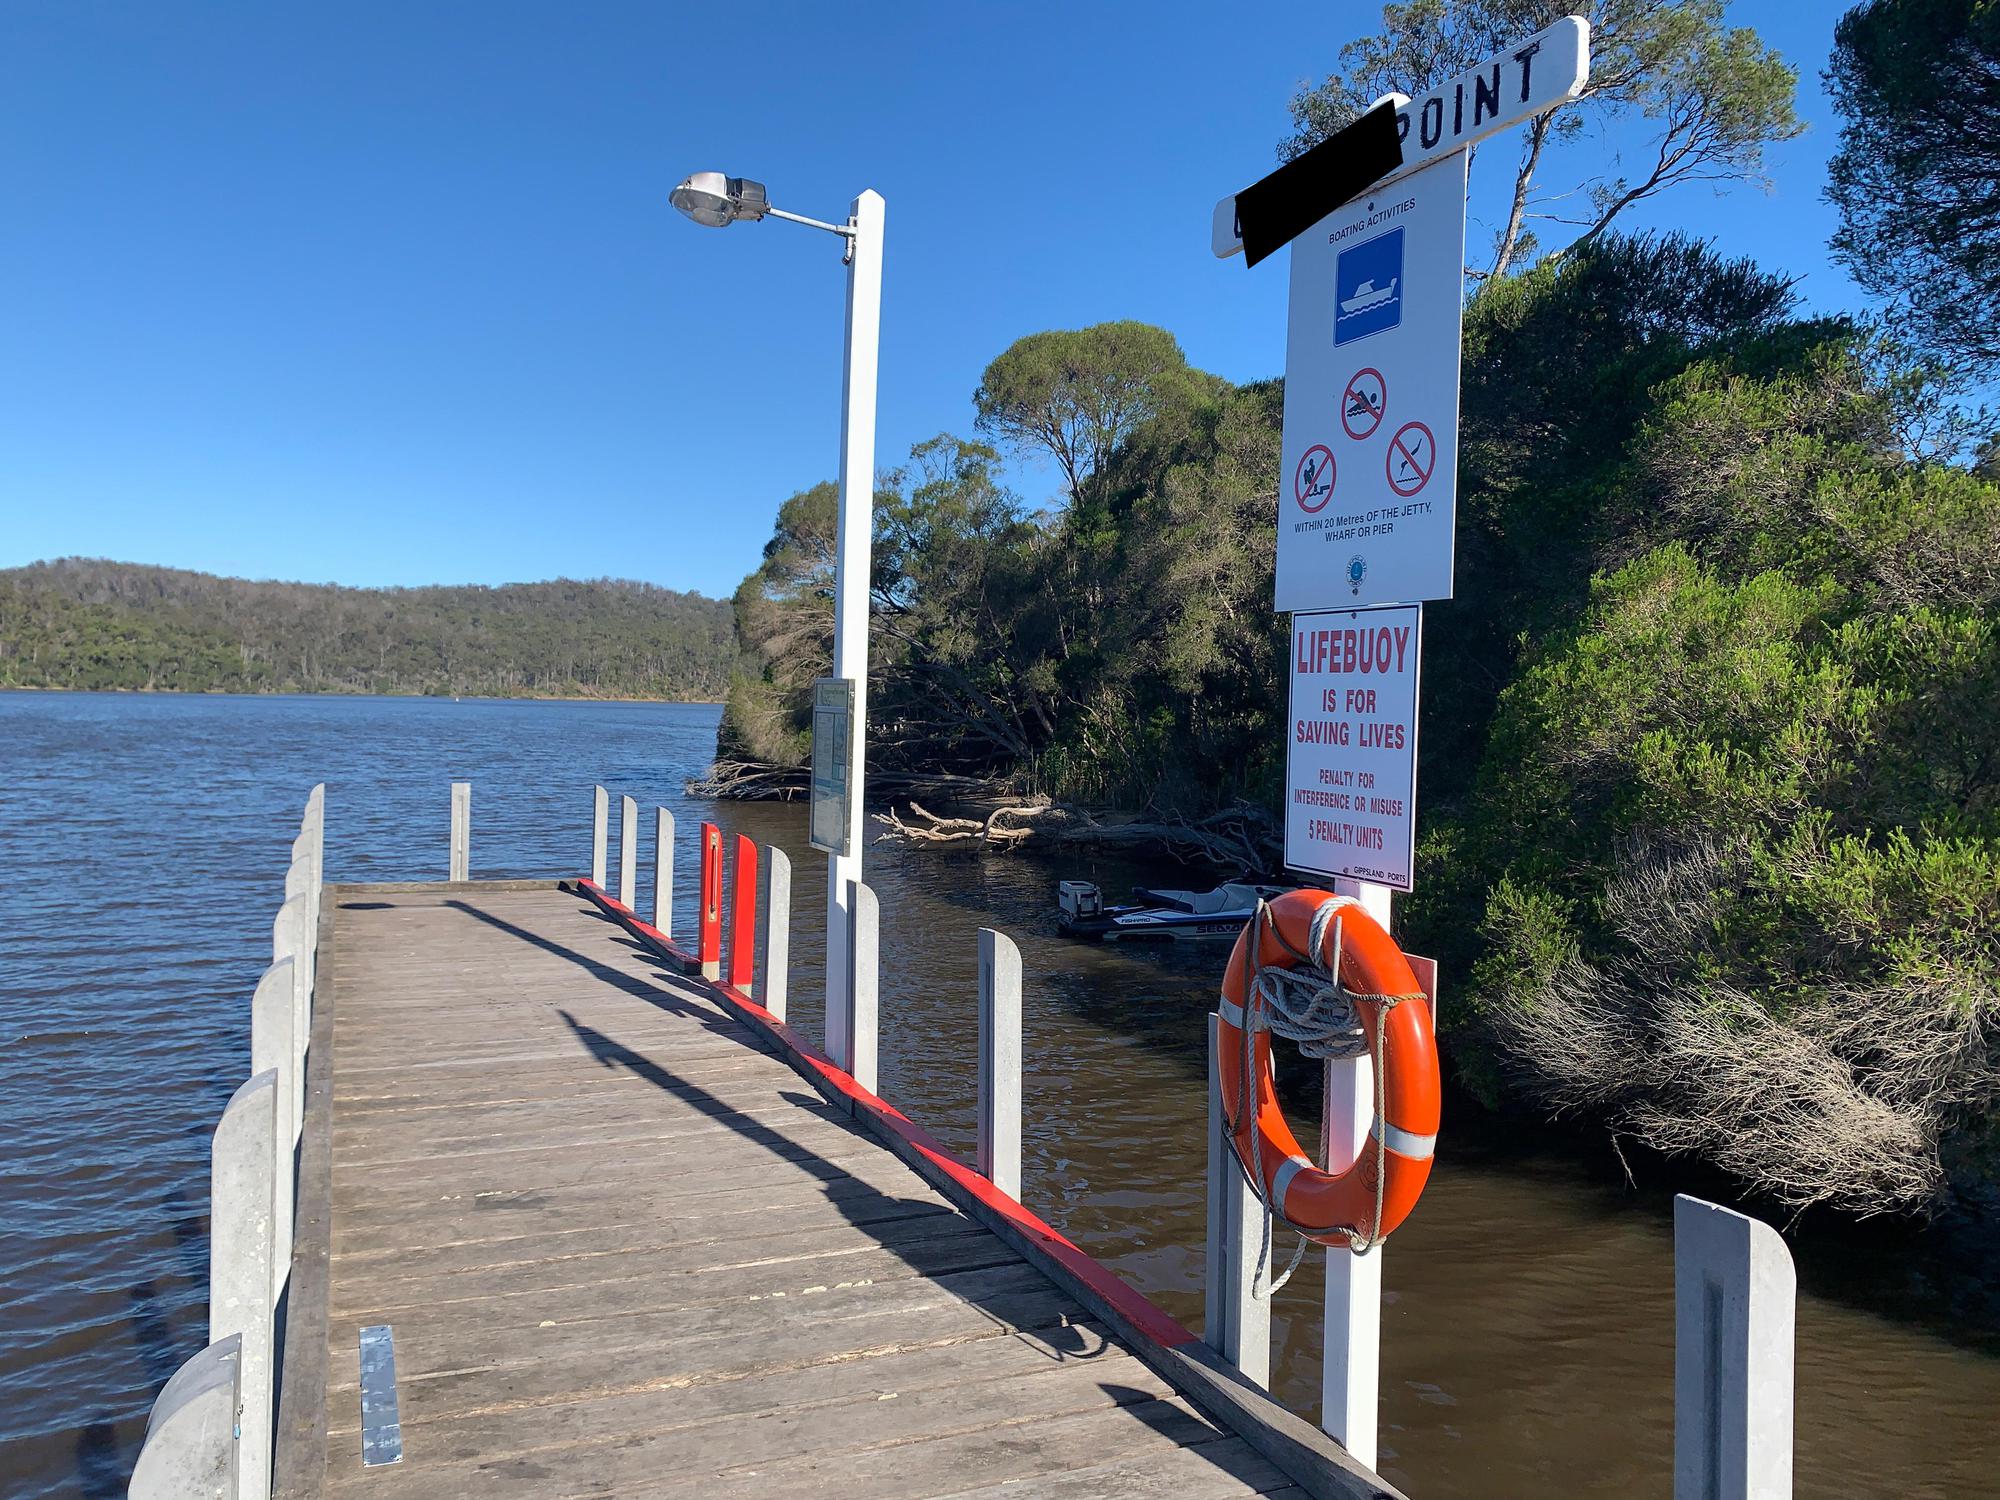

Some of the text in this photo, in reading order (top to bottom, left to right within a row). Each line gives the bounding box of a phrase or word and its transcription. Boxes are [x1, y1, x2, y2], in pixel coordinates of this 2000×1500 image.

[1329, 198, 1416, 244] BOATING ACTIVITIES
[1294, 502, 1432, 534] WITHIN 20 Metres OF THE JETTY,
[1325, 522, 1394, 542] WHARF OR PIER
[1297, 627, 1410, 673] LIFEBUOY
[1322, 688, 1377, 714] IS FOR
[1296, 719, 1405, 750] SAVING LIVES
[1319, 768, 1375, 789] PENALTY FOR
[1294, 788, 1403, 817] INTERFERENCE OR MISUSE
[1308, 819, 1384, 851] 5 PENALTY UNITS
[1354, 866, 1406, 883] GIPPSLAND PORTS
